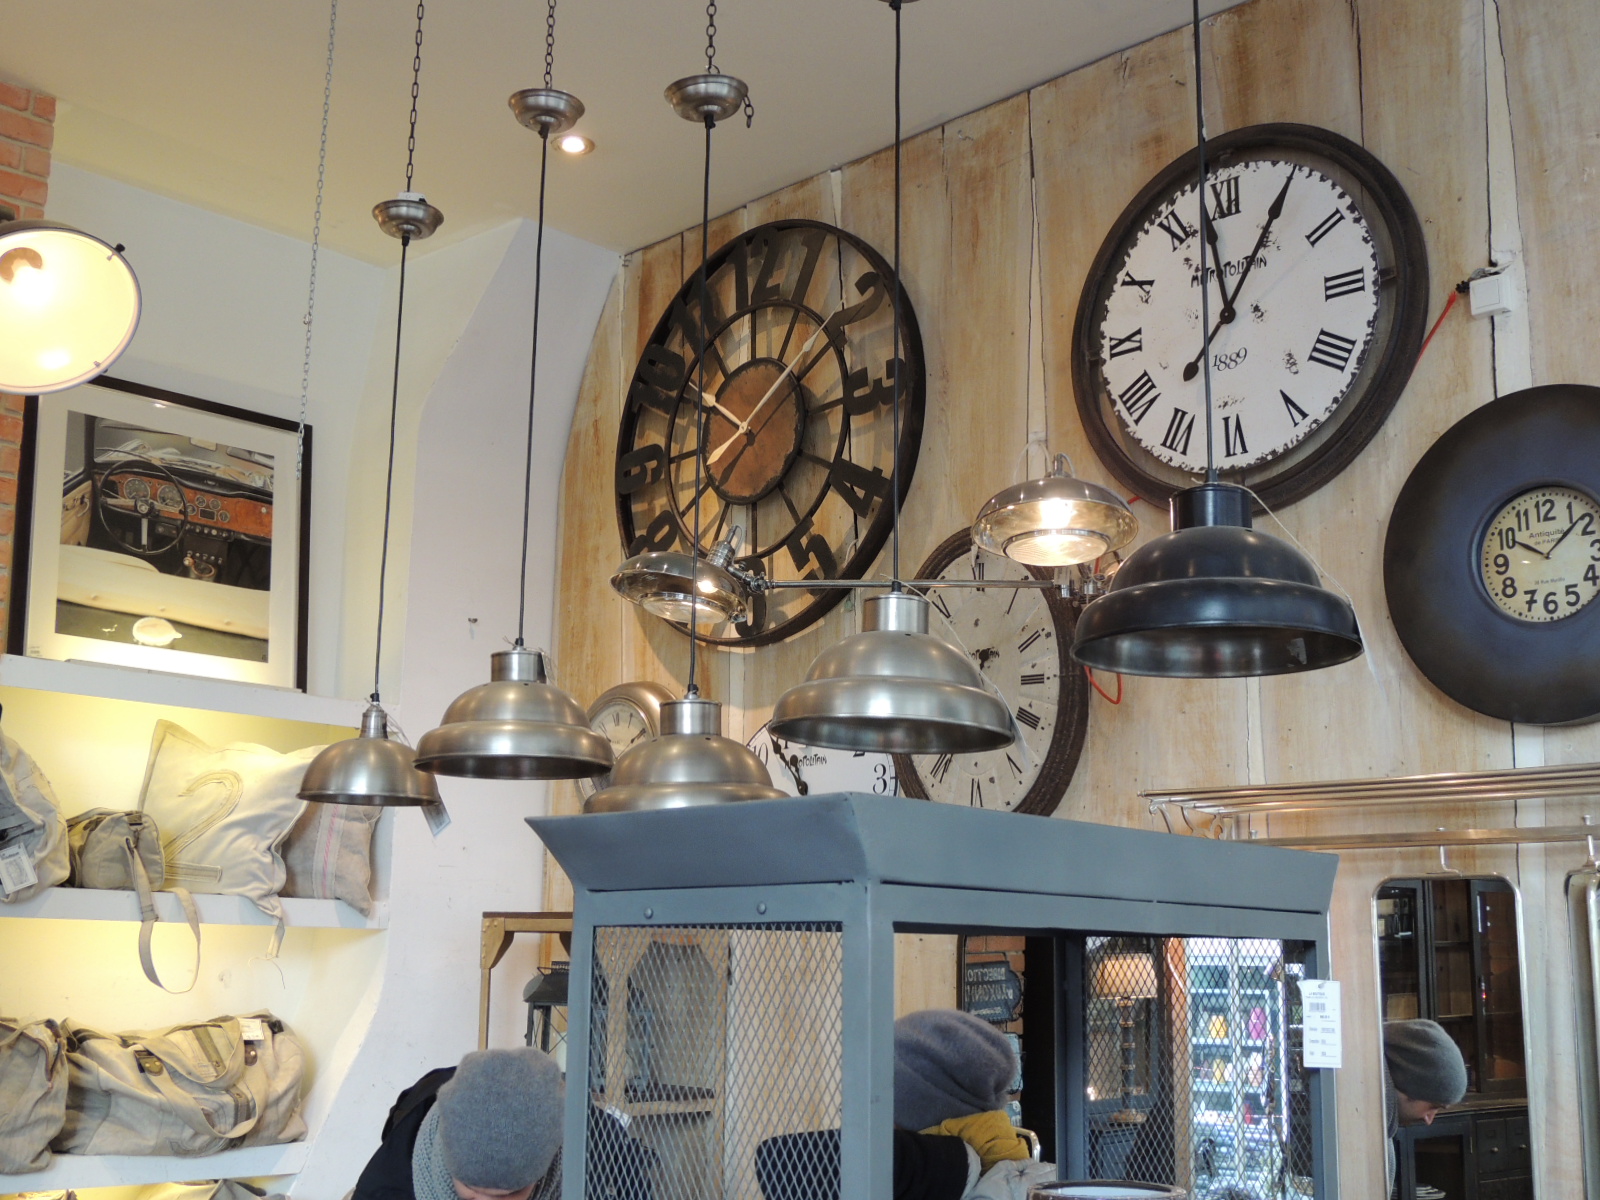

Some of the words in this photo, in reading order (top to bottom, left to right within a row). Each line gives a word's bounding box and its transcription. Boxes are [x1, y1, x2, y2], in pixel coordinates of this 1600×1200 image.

[1209, 175, 1241, 221] XII
[1156, 208, 1195, 252] XI
[1304, 207, 1346, 247] II
[725, 227, 780, 311] 12
[1121, 270, 1155, 296] X
[1324, 266, 1365, 302] III
[824, 271, 886, 349] 2
[1109, 327, 1143, 360] IX
[1211, 347, 1247, 372] 1889
[1307, 328, 1357, 373] IIII
[632, 344, 686, 417] 10
[843, 357, 906, 416] 3
[1118, 369, 1162, 427] VIII
[1279, 389, 1310, 428] V
[1160, 407, 1196, 457] VII
[1222, 413, 1249, 458] VI
[618, 443, 664, 494] 9
[829, 458, 892, 519] 4
[1515, 508, 1530, 532] 11
[1534, 499, 1556, 523] 12
[1566, 501, 1574, 524] 1
[1579, 512, 1596, 536] 2
[1498, 527, 1516, 551] 10
[785, 515, 838, 597] 5
[1493, 553, 1510, 575] 9
[1501, 577, 1518, 598] 8
[1583, 564, 1600, 586] 4
[1523, 589, 1538, 612] 7
[1543, 592, 1559, 615] 6
[1565, 584, 1580, 607] 5
[1018, 629, 1041, 653] II
[1020, 673, 1045, 686] III
[1015, 706, 1041, 731] IIII
[873, 763, 888, 795] 3
